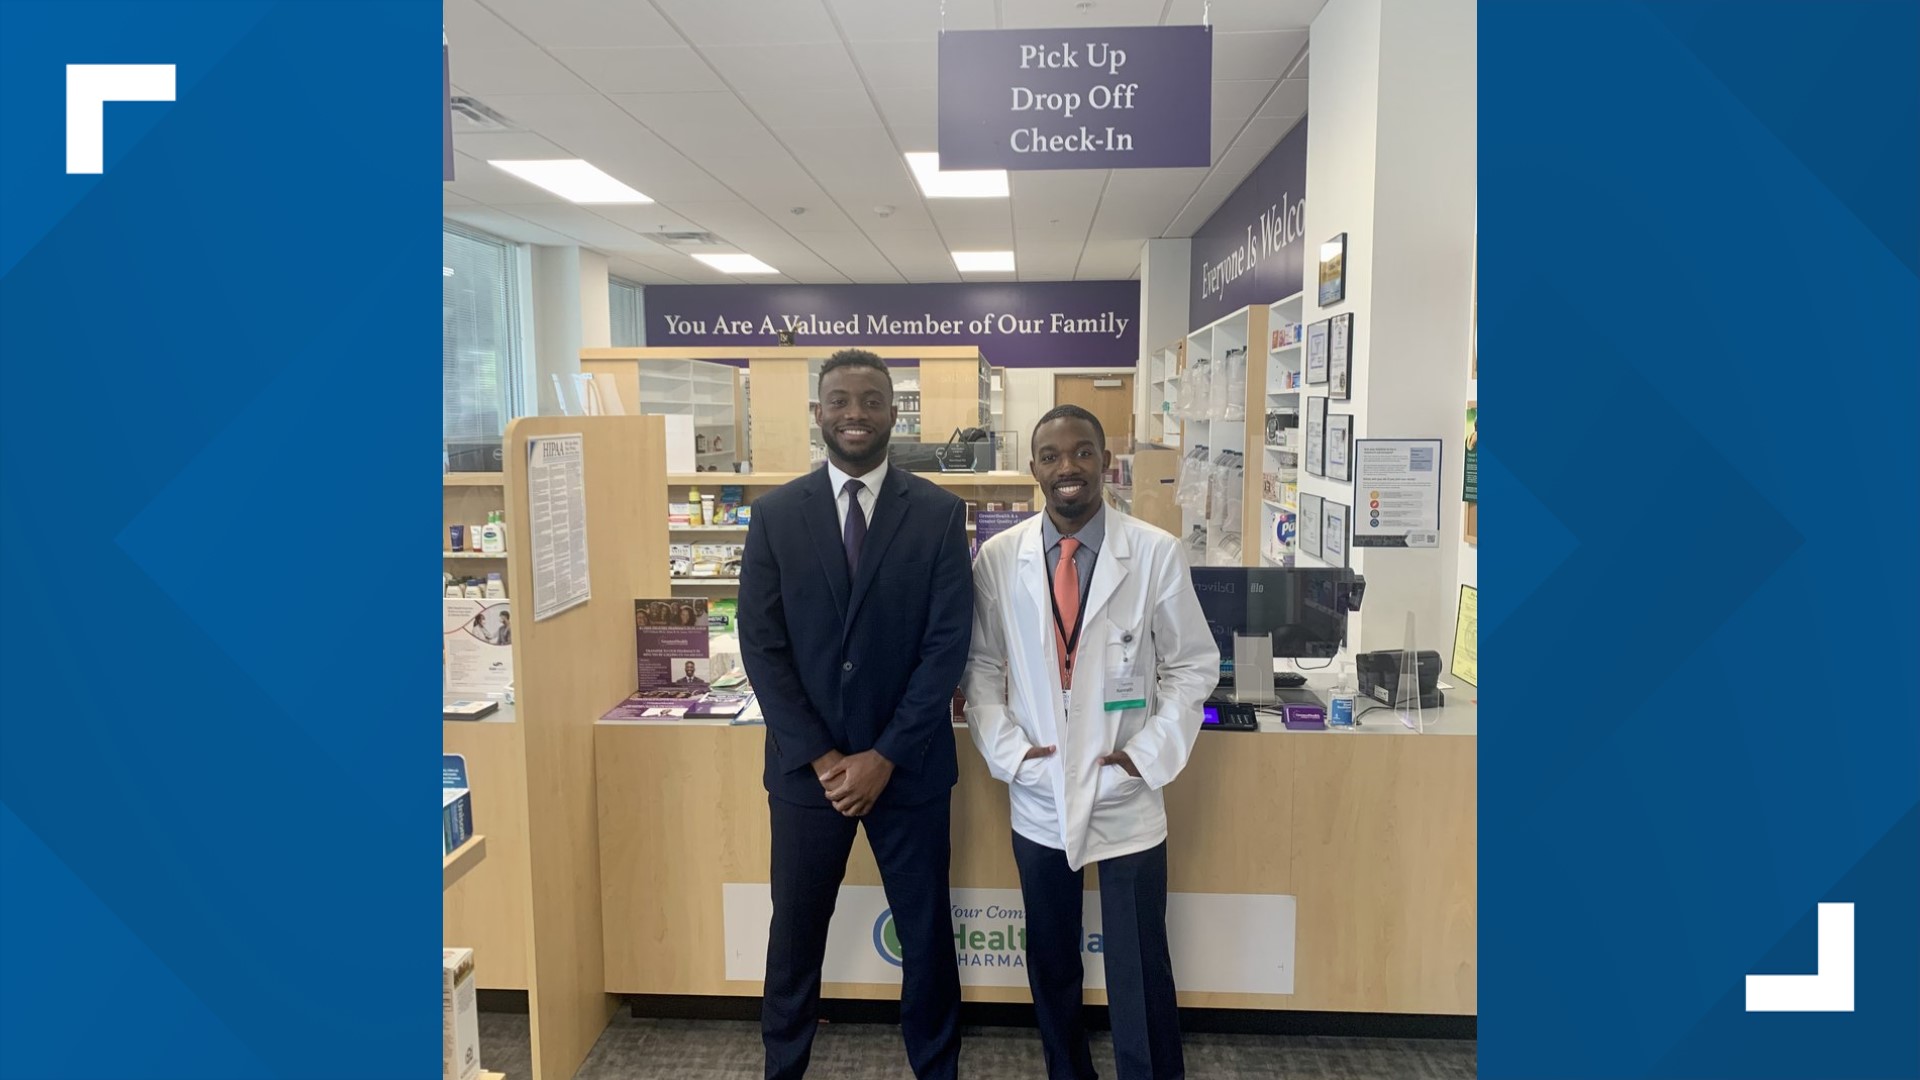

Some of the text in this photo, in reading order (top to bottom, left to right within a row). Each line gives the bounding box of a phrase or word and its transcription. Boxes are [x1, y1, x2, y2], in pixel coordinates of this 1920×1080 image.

[1020, 42, 1127, 75] Pick Up
[1010, 83, 1139, 118] Drop Off
[1010, 126, 1134, 153] Check-In
[1202, 245, 1245, 301] Everyone
[1246, 224, 1257, 271] Is
[664, 311, 1130, 339] You Are A Valued Member of Our Family
[542, 441, 565, 458] HIPAA
[986, 905, 1027, 919] Com
